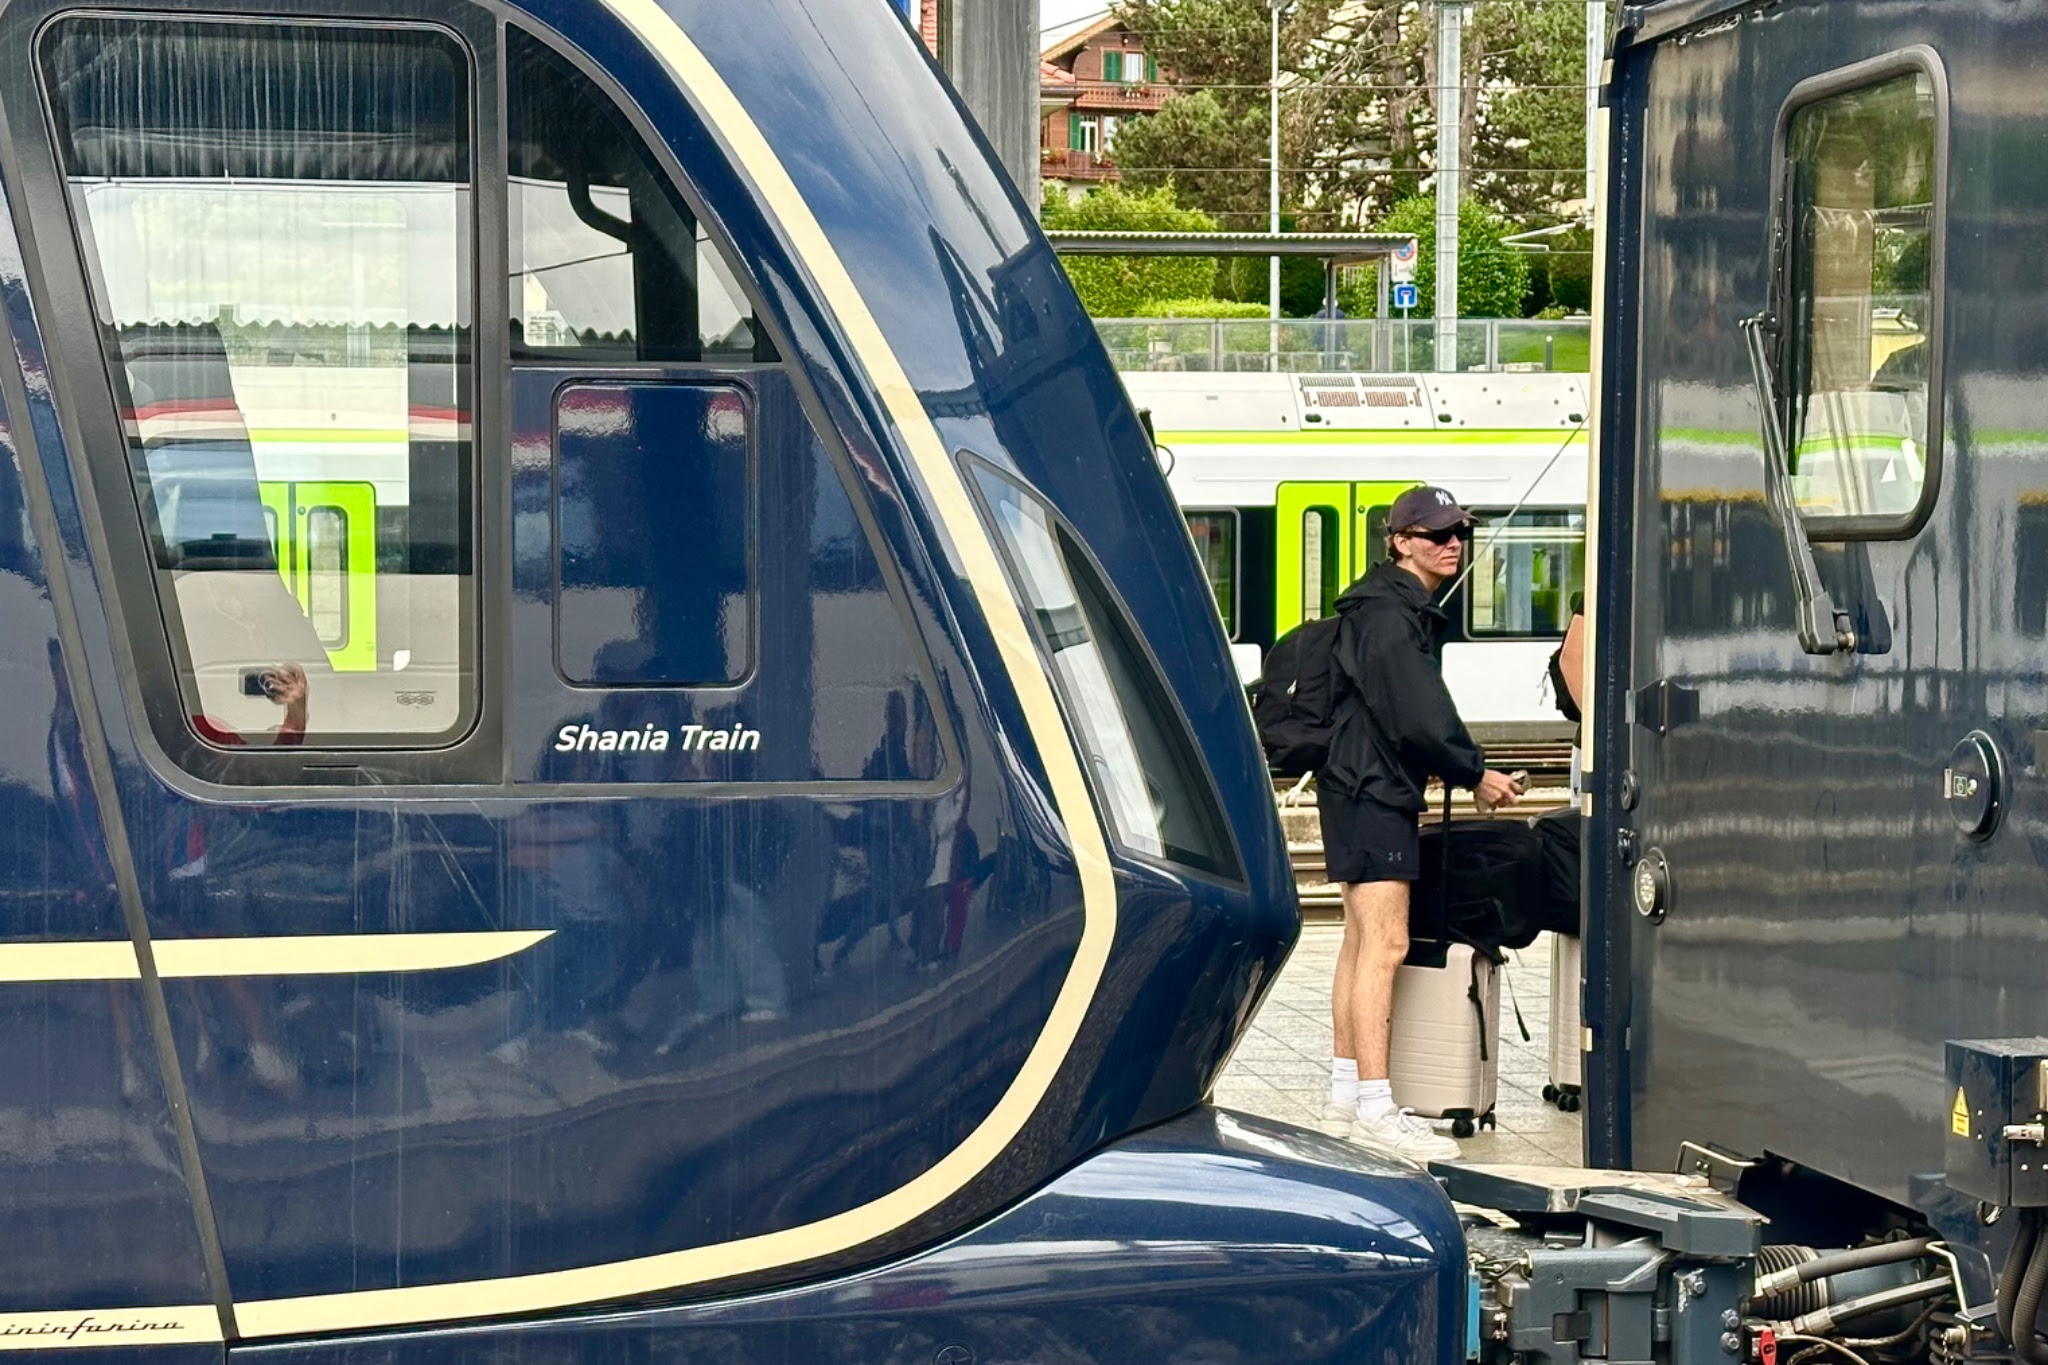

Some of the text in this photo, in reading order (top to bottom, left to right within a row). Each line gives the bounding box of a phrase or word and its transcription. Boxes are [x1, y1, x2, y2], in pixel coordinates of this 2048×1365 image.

[555, 723, 761, 751] Shania Train
[0, 1317, 185, 1340] ininfarina
